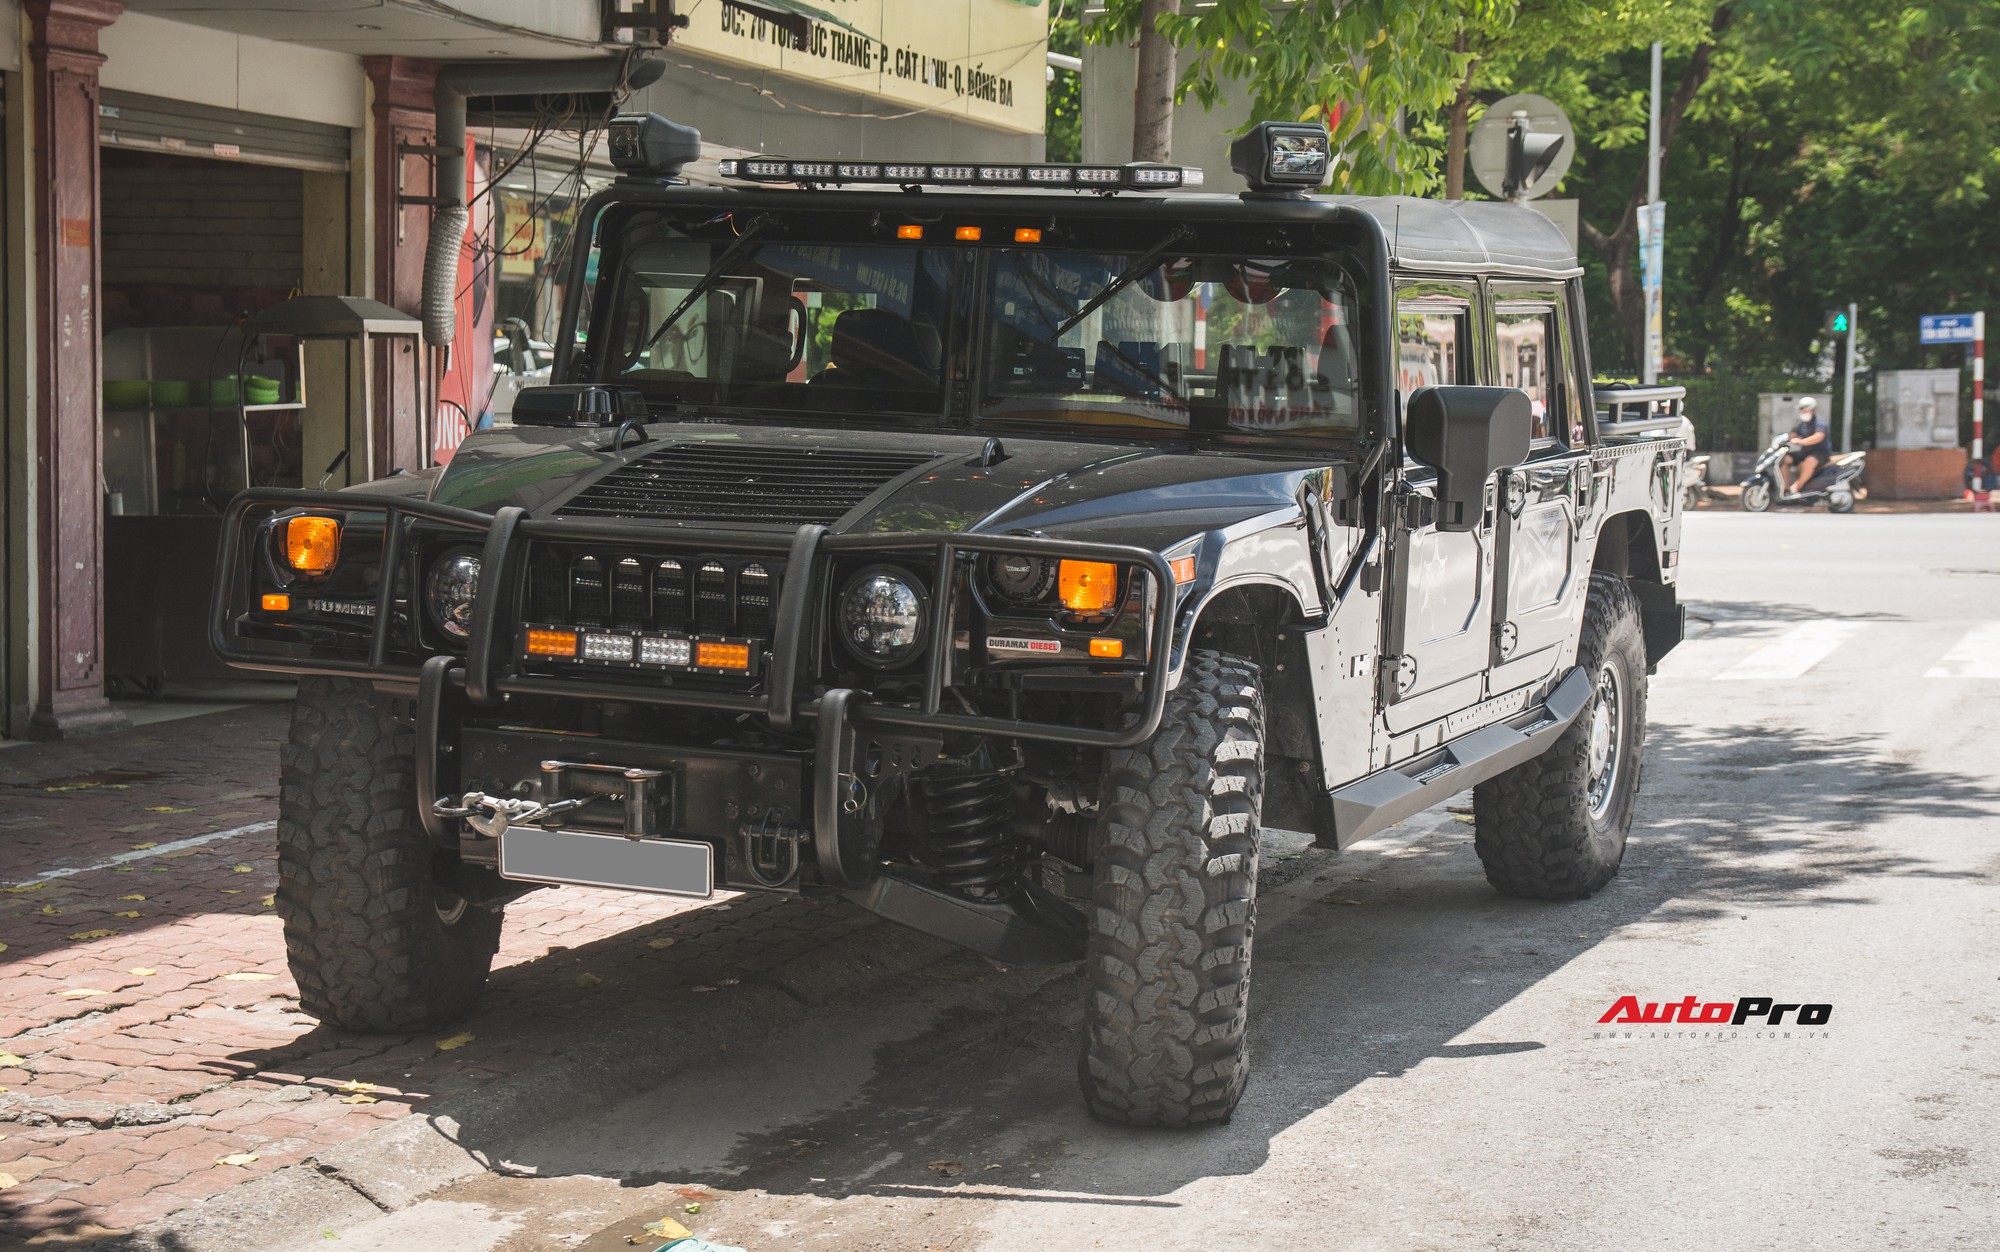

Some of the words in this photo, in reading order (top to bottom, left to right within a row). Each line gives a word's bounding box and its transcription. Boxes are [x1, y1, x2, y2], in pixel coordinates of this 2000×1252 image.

[896, 45, 918, 81] CÁT
[308, 599, 376, 616] HUMME
[989, 639, 1029, 649] DURAMAX
[1030, 641, 1058, 651] DIESEL
